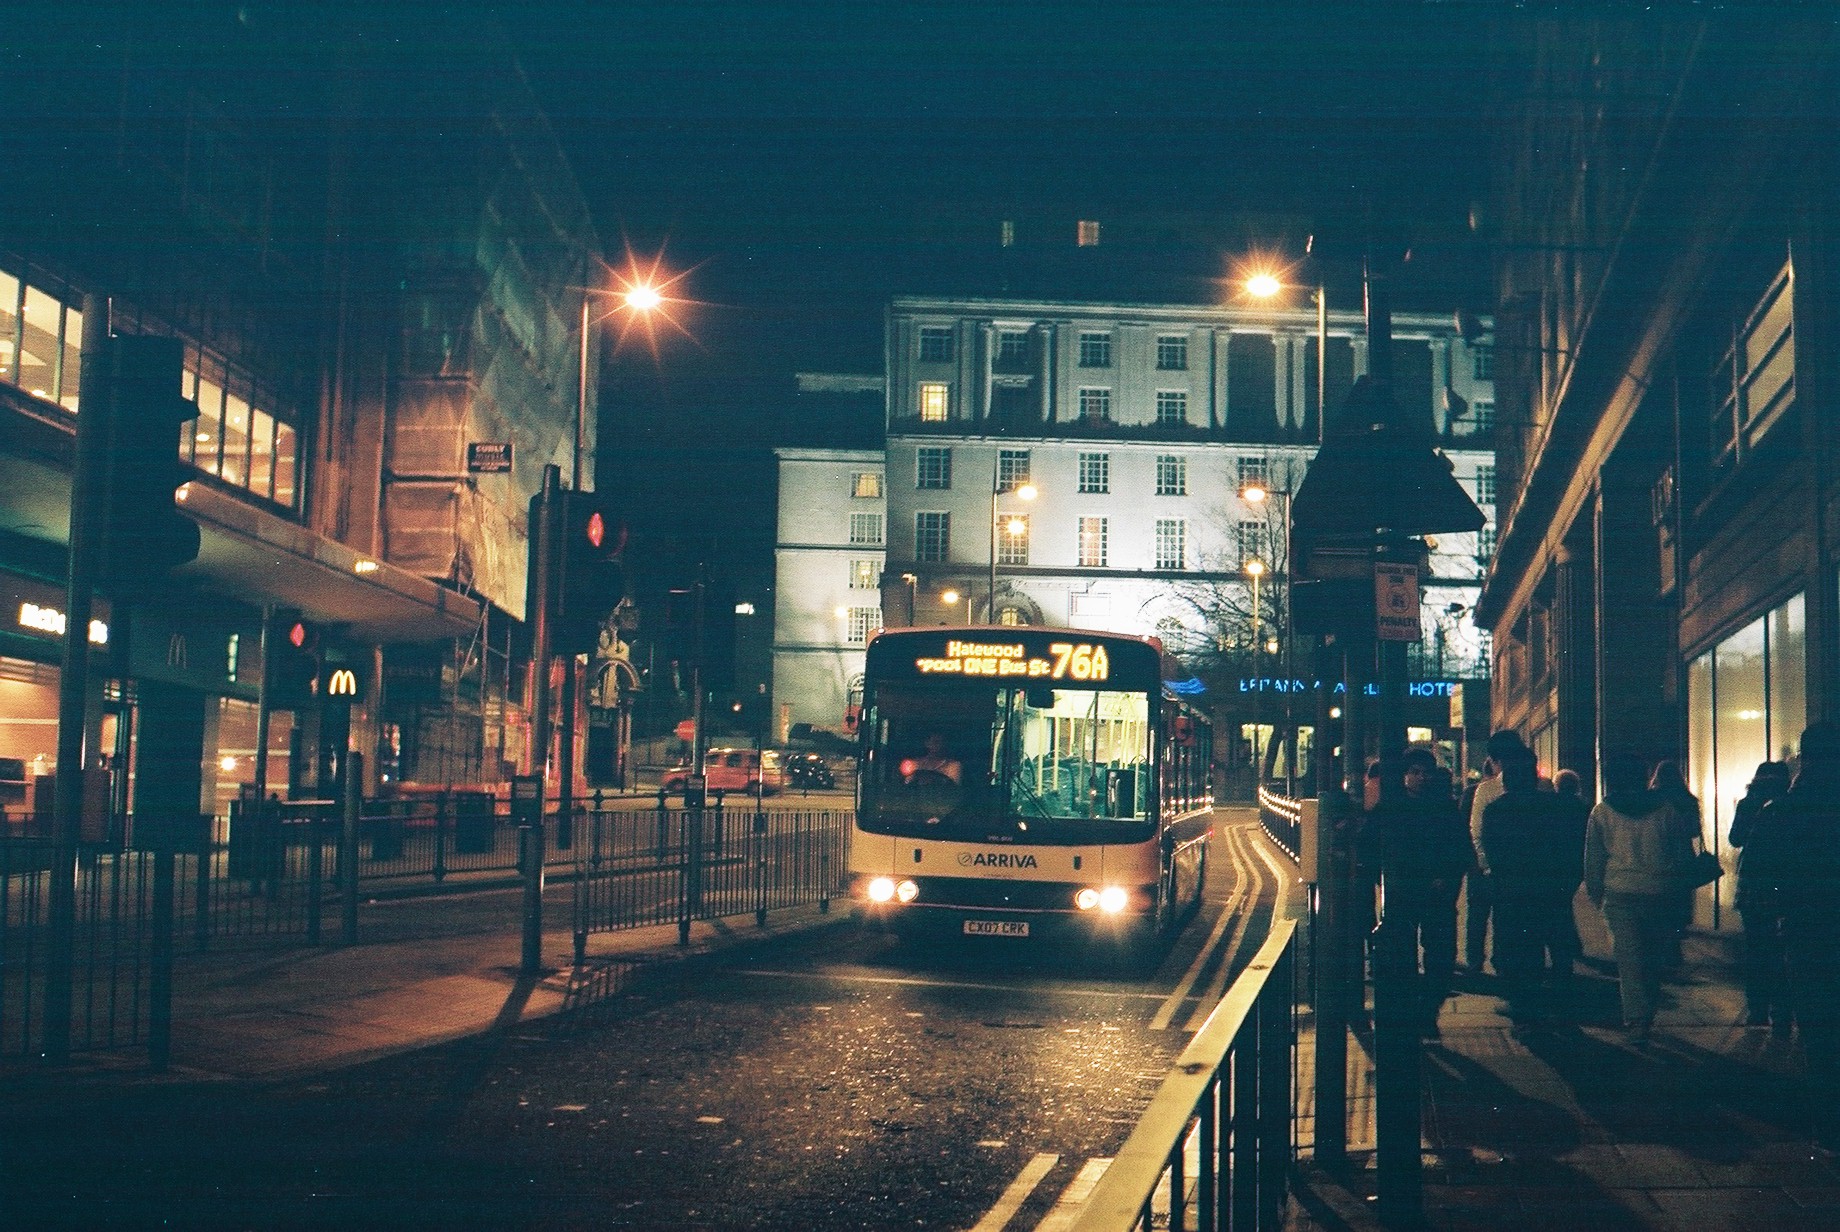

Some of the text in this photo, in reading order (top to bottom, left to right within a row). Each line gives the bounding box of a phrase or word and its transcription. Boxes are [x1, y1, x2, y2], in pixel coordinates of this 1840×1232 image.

[948, 641, 1023, 657] Halewood
[964, 657, 997, 674] ONE
[999, 658, 1027, 675] Bus
[1051, 643, 1108, 679] 76A
[1409, 682, 1454, 696] HOTE
[973, 853, 1038, 868] ARRIVA
[968, 922, 1025, 934] CX07 CRK
